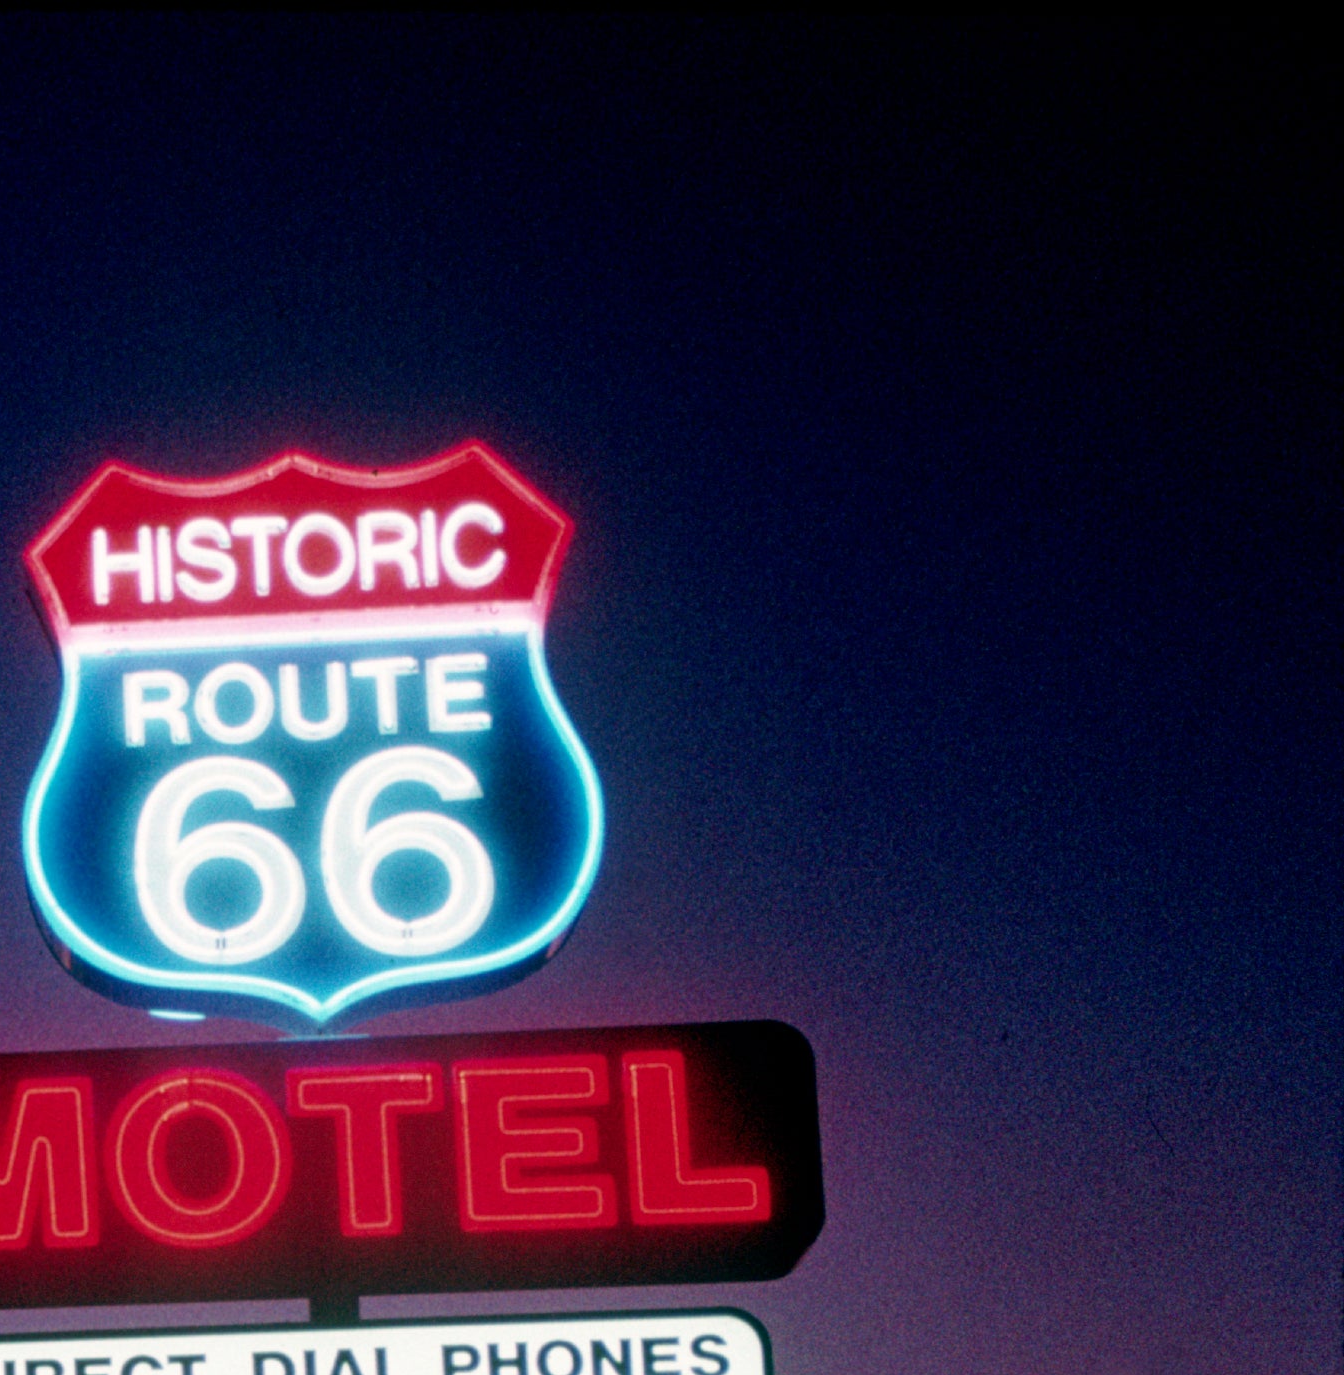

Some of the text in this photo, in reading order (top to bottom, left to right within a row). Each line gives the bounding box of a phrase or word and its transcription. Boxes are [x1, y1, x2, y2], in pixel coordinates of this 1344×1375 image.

[91, 501, 507, 606] HISTORIC
[121, 653, 492, 748] ROUTE
[133, 745, 495, 965] 66
